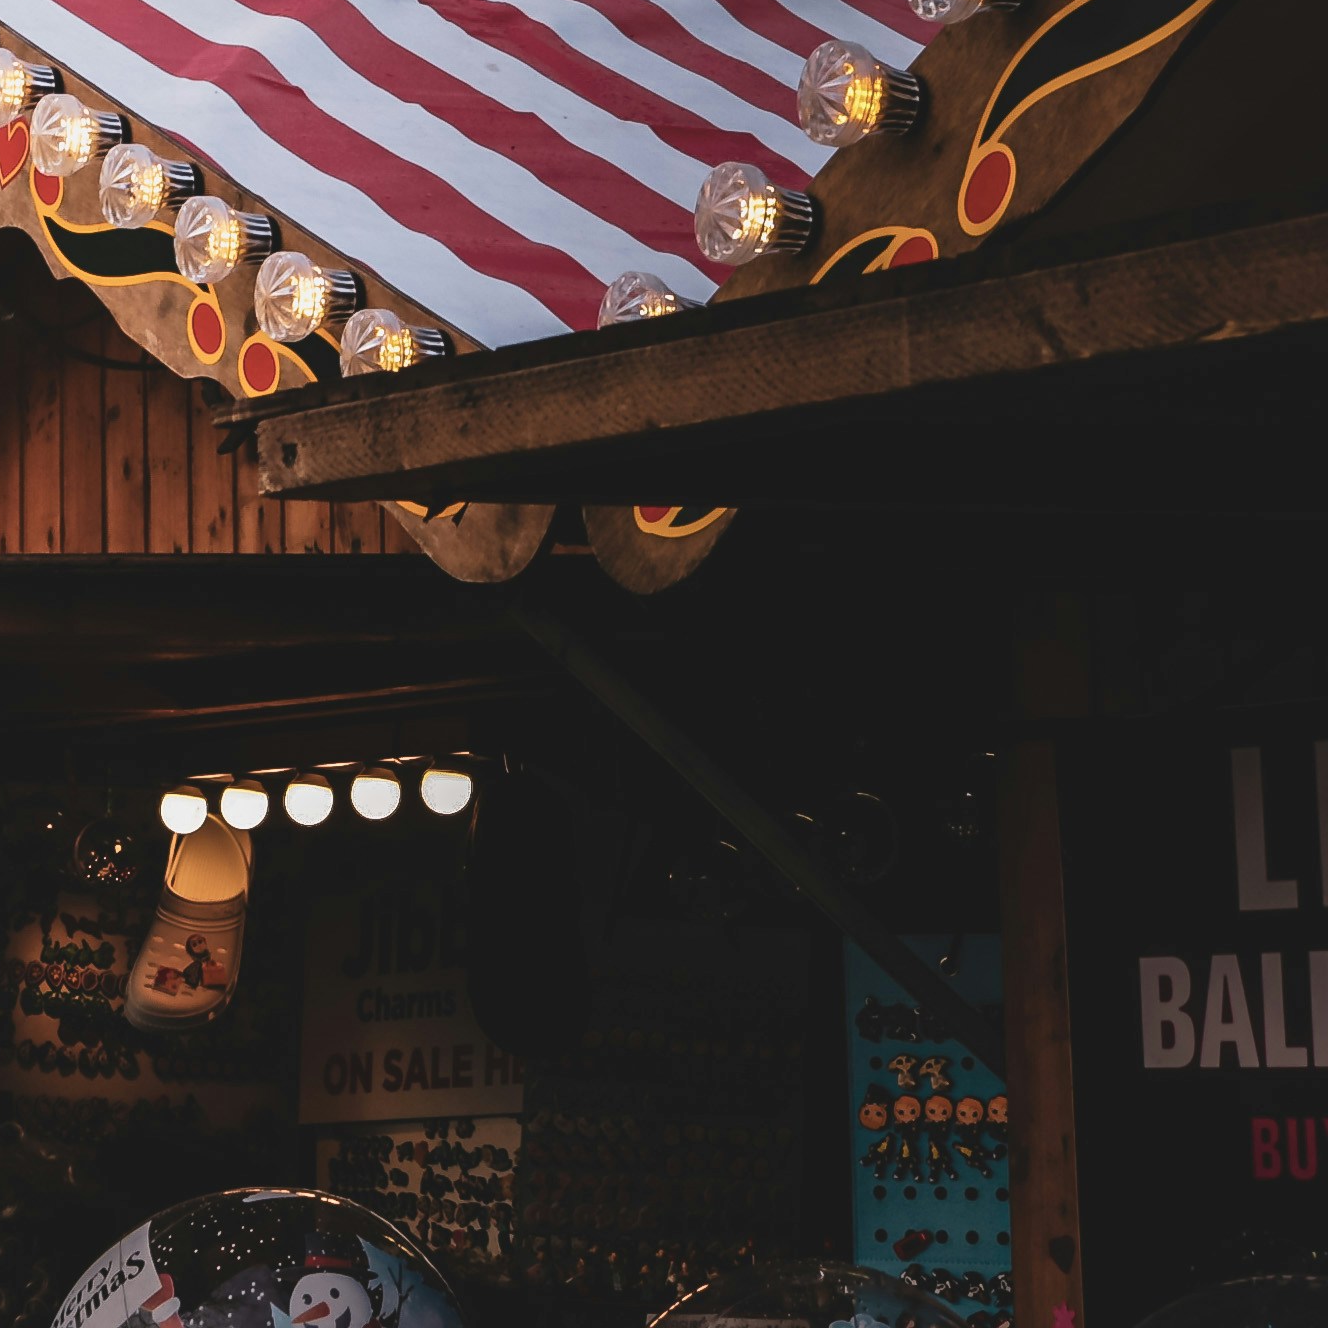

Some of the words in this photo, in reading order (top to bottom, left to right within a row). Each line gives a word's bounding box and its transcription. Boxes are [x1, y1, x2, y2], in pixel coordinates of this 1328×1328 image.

[356, 988, 457, 1021] Charms
[323, 1051, 374, 1096] ON
[382, 1043, 474, 1093] SALE
[1251, 1117, 1328, 1181] BU
